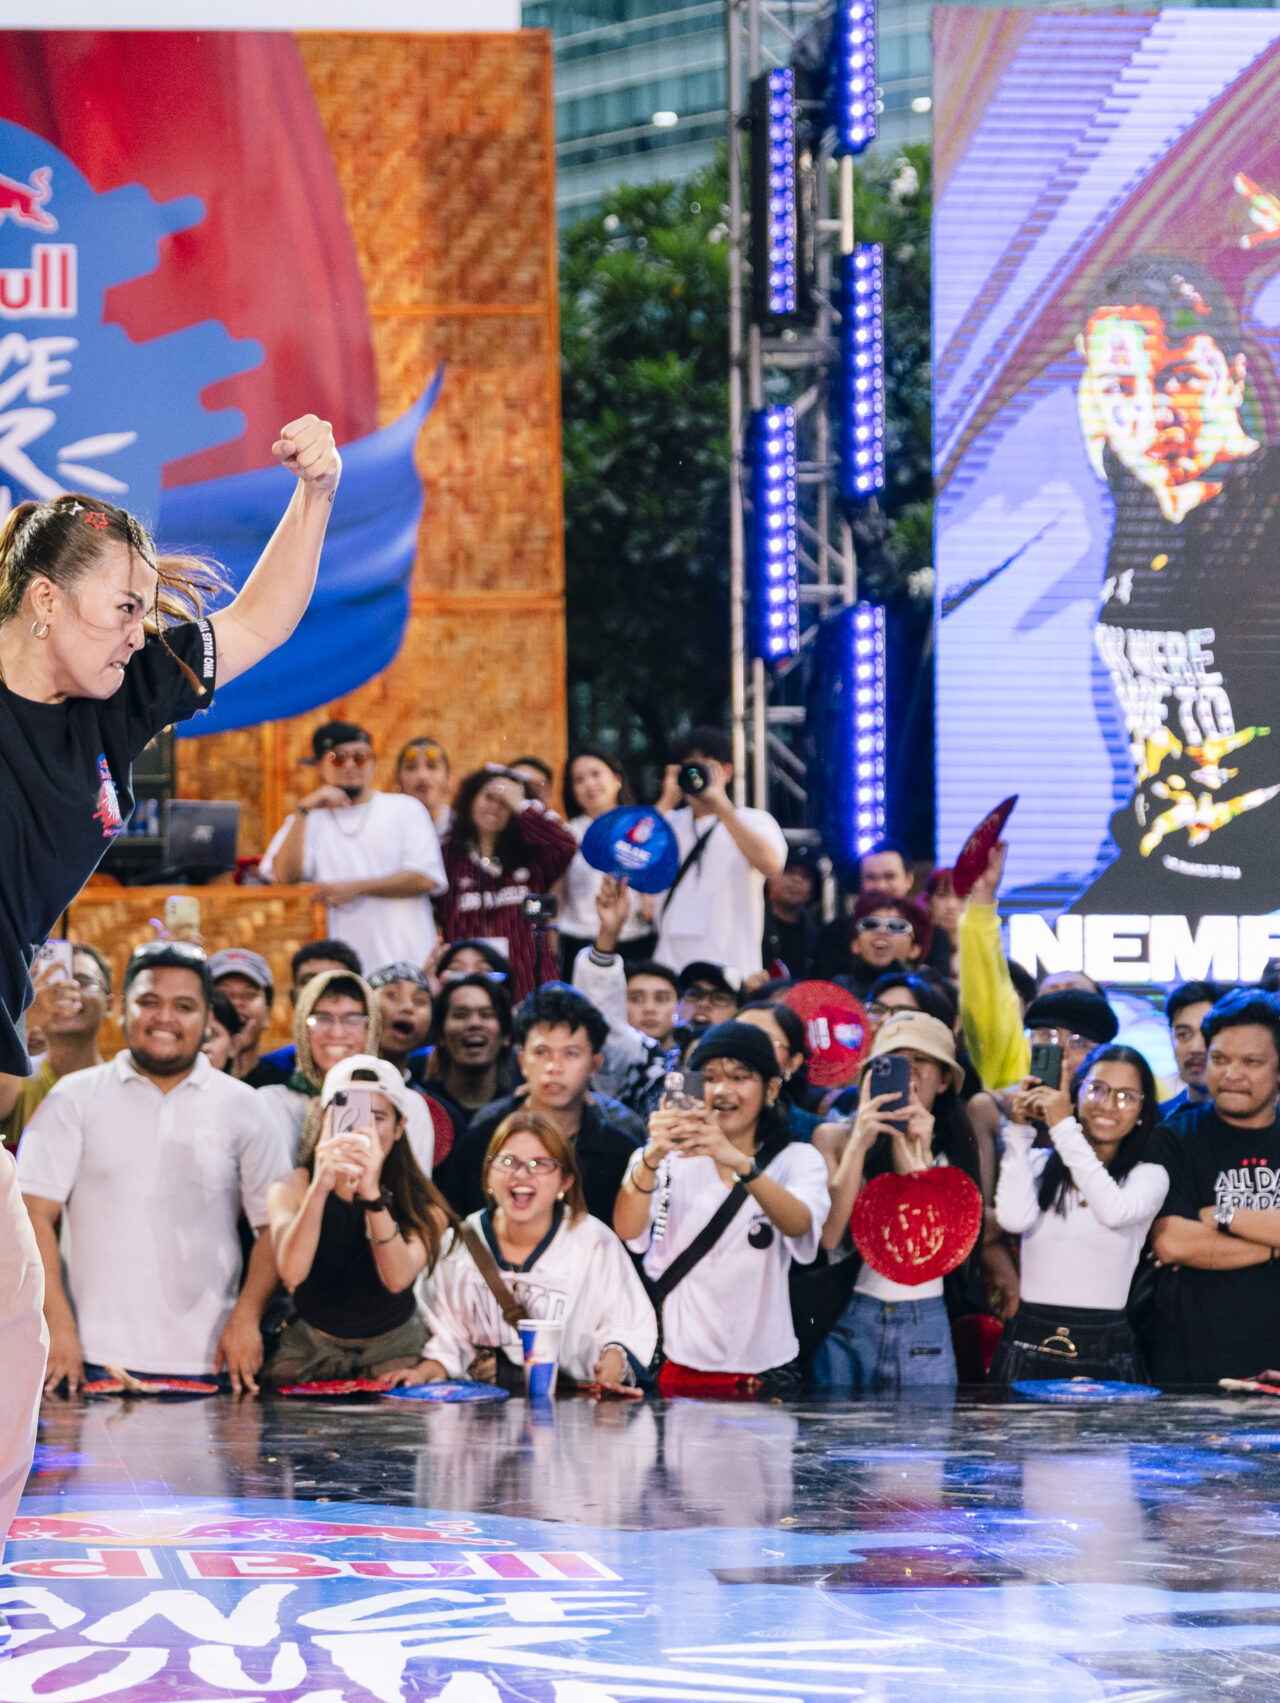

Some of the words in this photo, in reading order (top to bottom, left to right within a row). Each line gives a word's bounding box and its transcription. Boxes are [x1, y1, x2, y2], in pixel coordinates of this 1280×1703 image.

[202, 632, 214, 656] RULES
[202, 657, 214, 678] WHO
[1214, 1167, 1254, 1192] ALL
[178, 1551, 621, 1581] Bull
